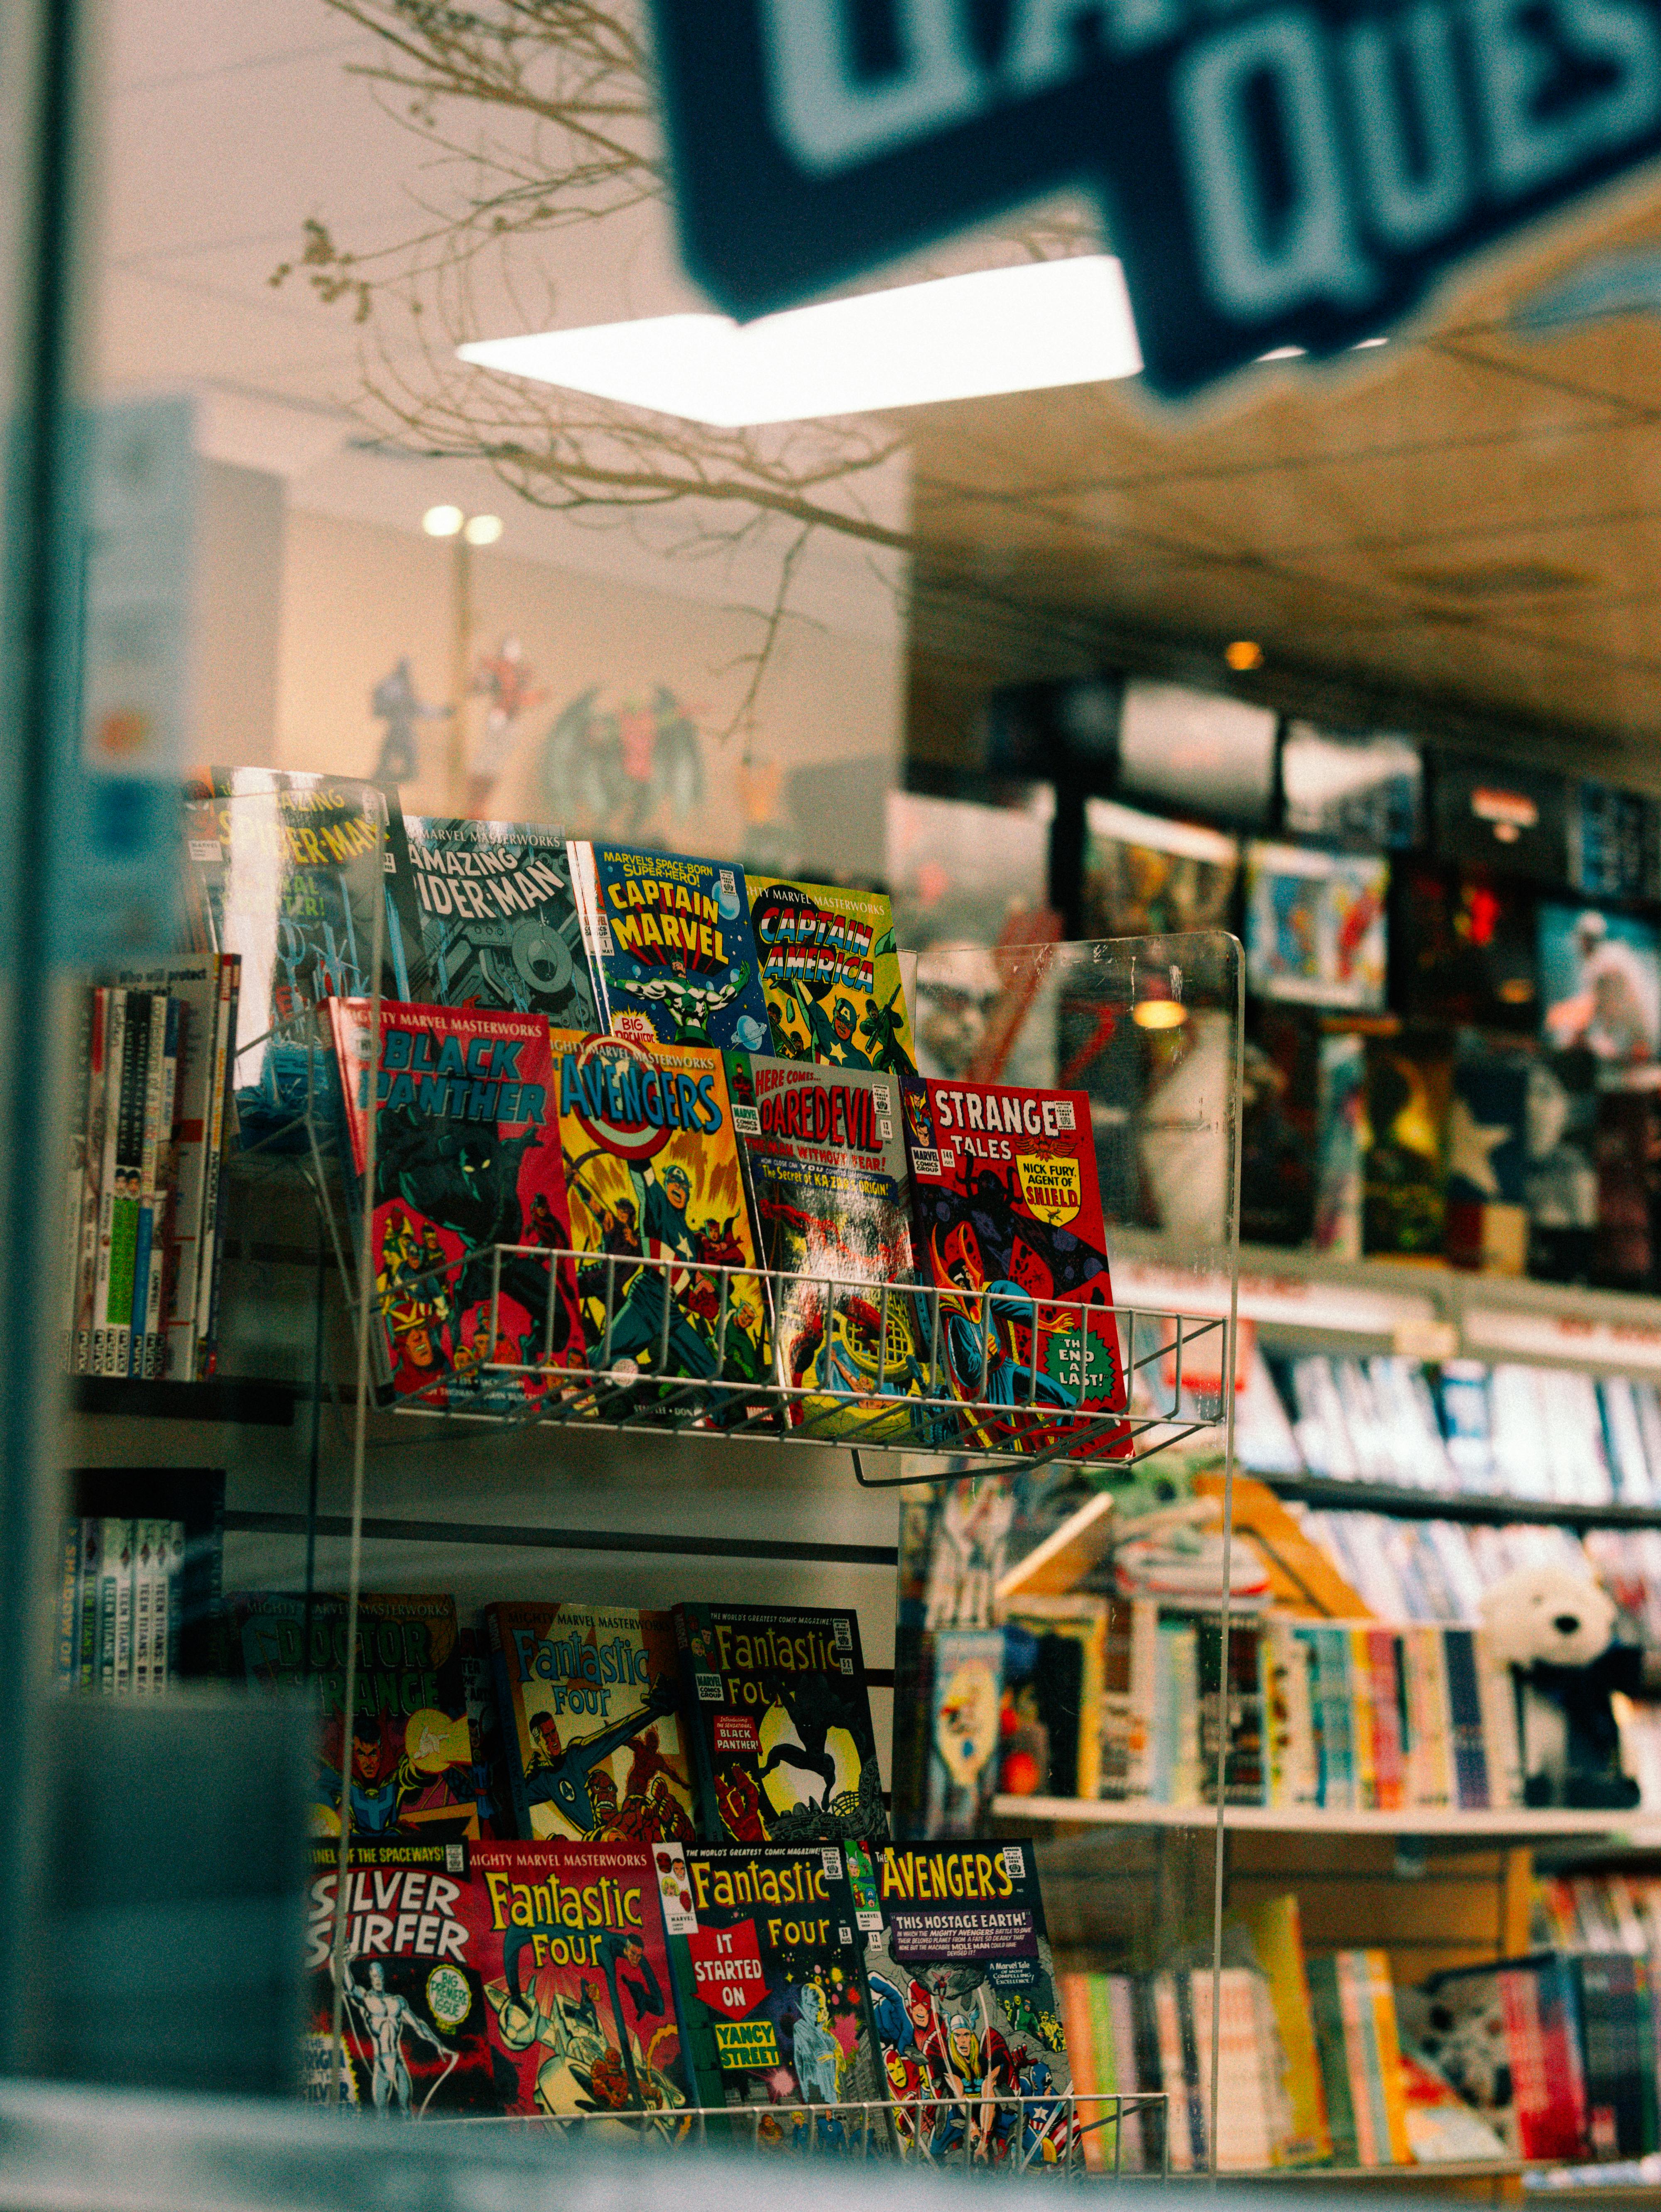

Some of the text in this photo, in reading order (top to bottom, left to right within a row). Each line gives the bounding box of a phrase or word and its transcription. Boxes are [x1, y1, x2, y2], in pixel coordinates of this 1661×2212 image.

[420, 830, 561, 847] MARVEL MASTERWORKS
[409, 843, 517, 876] AMAZING
[604, 852, 654, 867] MARVEL'S
[656, 858, 713, 877] SPACE-BORN
[623, 864, 701, 888] SUPER-HERO!
[414, 860, 565, 918] IDER-MAN
[608, 879, 719, 925] CAPTAIN
[773, 889, 884, 915] MARVEL MASTERWORKS
[610, 913, 729, 965] MARVEL
[759, 907, 874, 958] CAPTAIN
[762, 946, 874, 995] AMERICA
[399, 1013, 542, 1037] MARVEL MASTERWORKS
[622, 1017, 643, 1031] BIG
[383, 1030, 524, 1081] BLACK
[550, 1039, 715, 1070] IGHTY MARVEL MASTERWORKS
[561, 1054, 723, 1135] AVENGERS
[756, 1070, 784, 1097] HERE
[358, 1069, 548, 1126] PANTHER
[733, 1107, 758, 1120] MARVEL
[761, 1085, 884, 1153] DAREDEVIL
[934, 1089, 1060, 1138] STRANGE
[745, 1138, 886, 1172] THE MAN WITHOUT FEAR!
[914, 1150, 939, 1162] MARVEL
[950, 1135, 1012, 1161] TALES
[777, 1166, 803, 1182] Secret
[804, 1171, 812, 1185] of
[800, 1163, 823, 1172] YOU
[1023, 1163, 1077, 1178] NICK FURY,
[1028, 1175, 1073, 1187] AGENT OF
[1059, 1349, 1095, 1362] END
[358, 1603, 449, 1616] MASTERWORKS
[558, 1613, 595, 1627] MARVEL
[599, 1617, 671, 1631] MASTERWORKS
[276, 1619, 428, 1668] DOCTOR
[714, 1625, 841, 1672] Fantastic
[512, 1629, 653, 1686] Fantastic
[843, 1659, 850, 1668] 52
[697, 1675, 722, 1687] MARVEL
[717, 1740, 759, 1750] PANTHER!
[720, 1729, 751, 1738] BLACK
[357, 1847, 377, 1863] THE
[380, 1846, 445, 1863] SPACEWAYS!
[470, 1854, 512, 1866] MIGHTY
[517, 1854, 560, 1867] MARVEL
[565, 1854, 647, 1867] MASTERWORKS
[690, 1860, 830, 1909] Fantastic
[880, 1847, 1013, 1901] AVENGERS
[308, 1870, 460, 1922] SILVER
[484, 1871, 644, 1931] Fantastic
[924, 1914, 979, 1929] HOSTAGE
[304, 1913, 470, 1969] SURFER
[716, 1933, 733, 1954] IT
[871, 1934, 878, 1943] 12
[694, 1959, 762, 1982] STARTED
[995, 1961, 1017, 1970] Marvel
[442, 1972, 459, 1987] BIG
[722, 1986, 746, 2007] ON
[717, 2024, 772, 2046] YANCY
[721, 2047, 779, 2067] STREET
